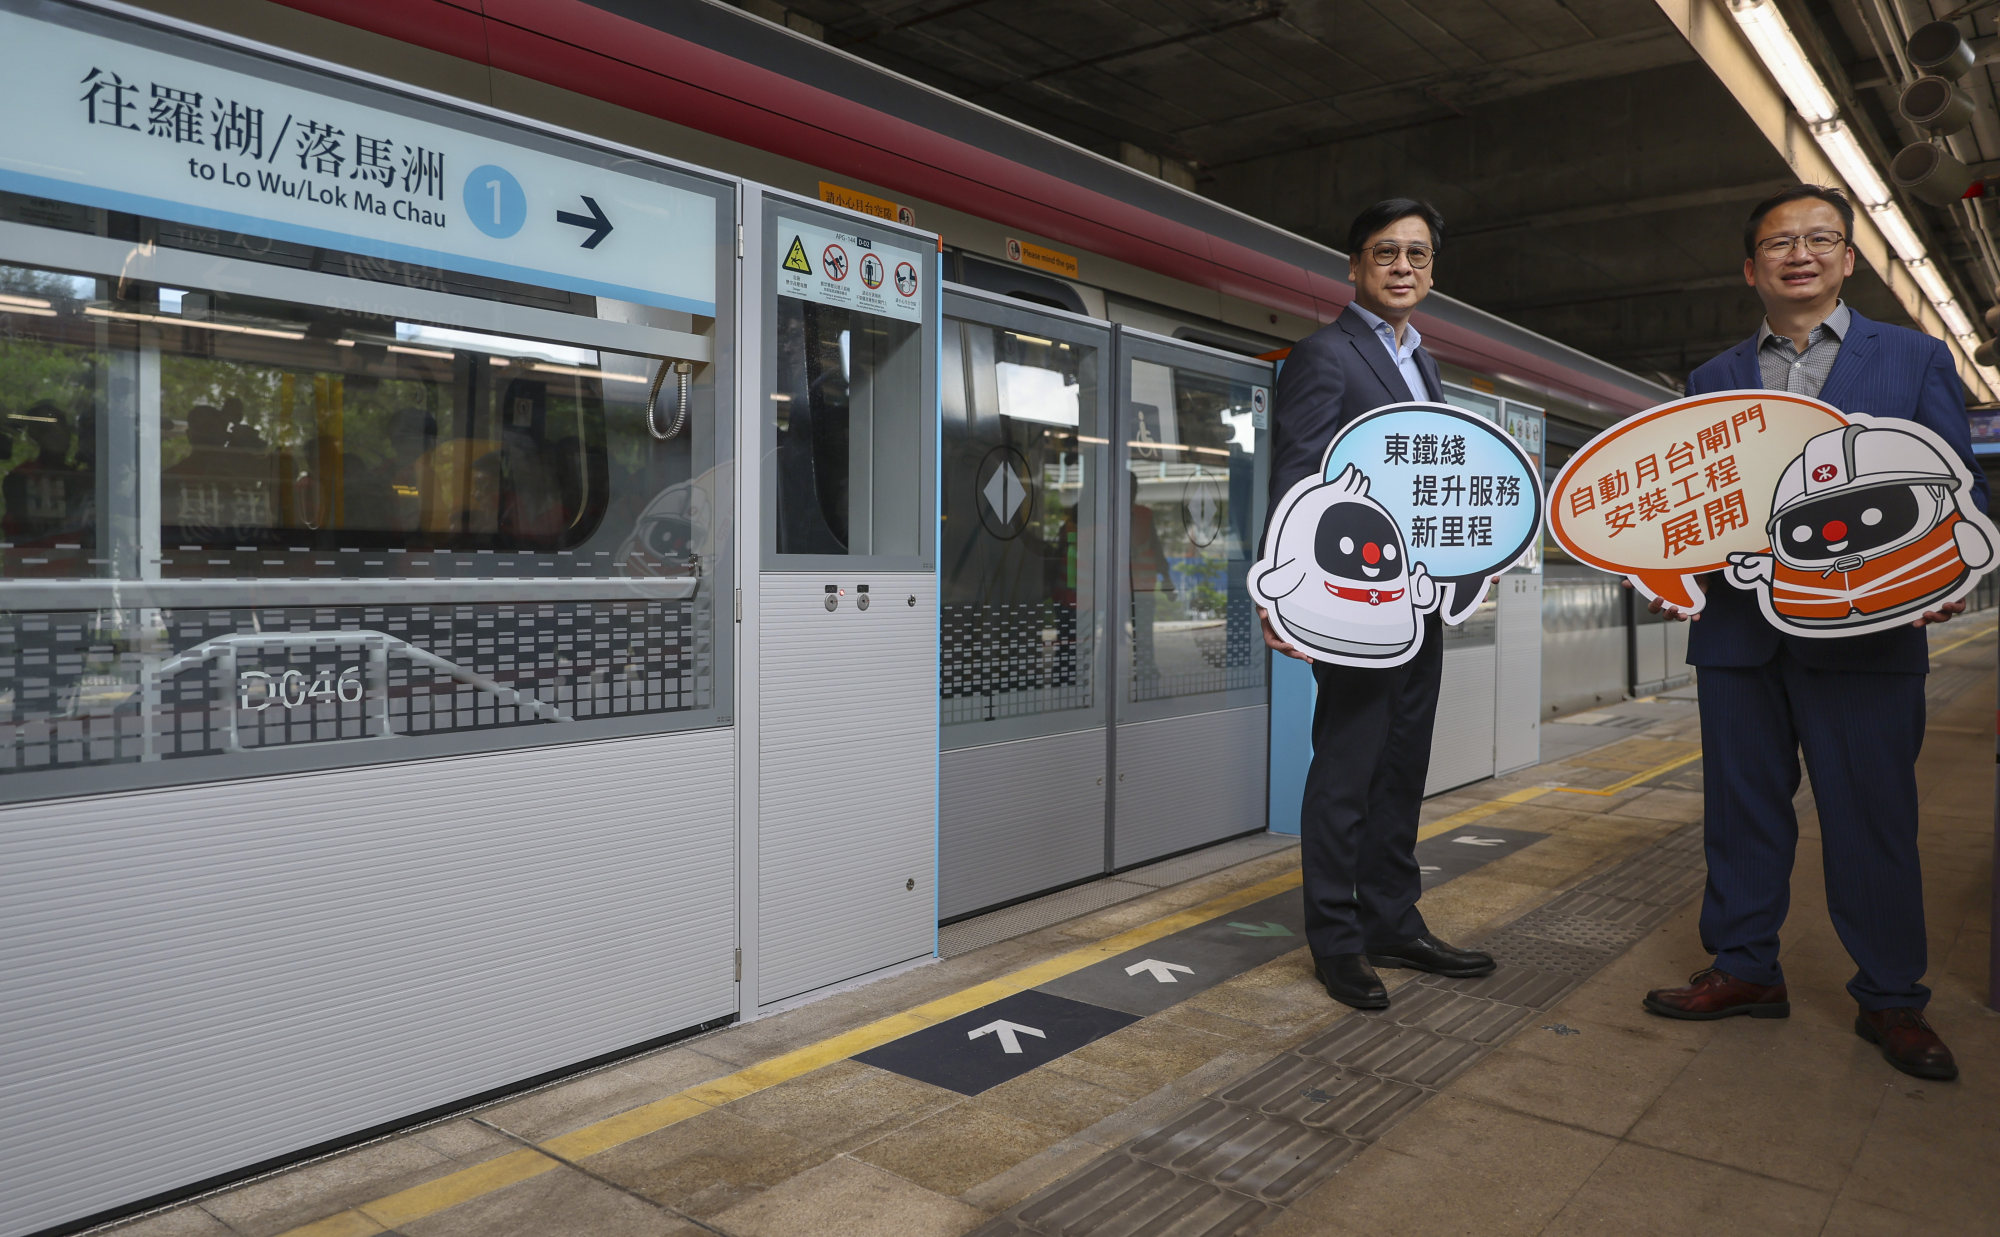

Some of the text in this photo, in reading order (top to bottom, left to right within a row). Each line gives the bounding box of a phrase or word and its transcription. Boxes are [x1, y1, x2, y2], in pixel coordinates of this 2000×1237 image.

[80, 67, 445, 201] 往羅湖/落馬洲
[188, 157, 446, 229] to Lo Wu/Lok Ma Chau
[485, 179, 501, 225] 1
[1023, 247, 1040, 260] Please
[1041, 254, 1055, 265] mind
[1065, 262, 1075, 272] gap
[1383, 432, 1466, 466] 東鐵綫
[1569, 403, 1767, 518] 自動月台閘門
[1412, 474, 1521, 507] 提升服務
[1604, 454, 1741, 539] 安裝工程
[1411, 515, 1493, 548] 新里程
[1661, 488, 1749, 559] 展開
[240, 665, 363, 711] D046
